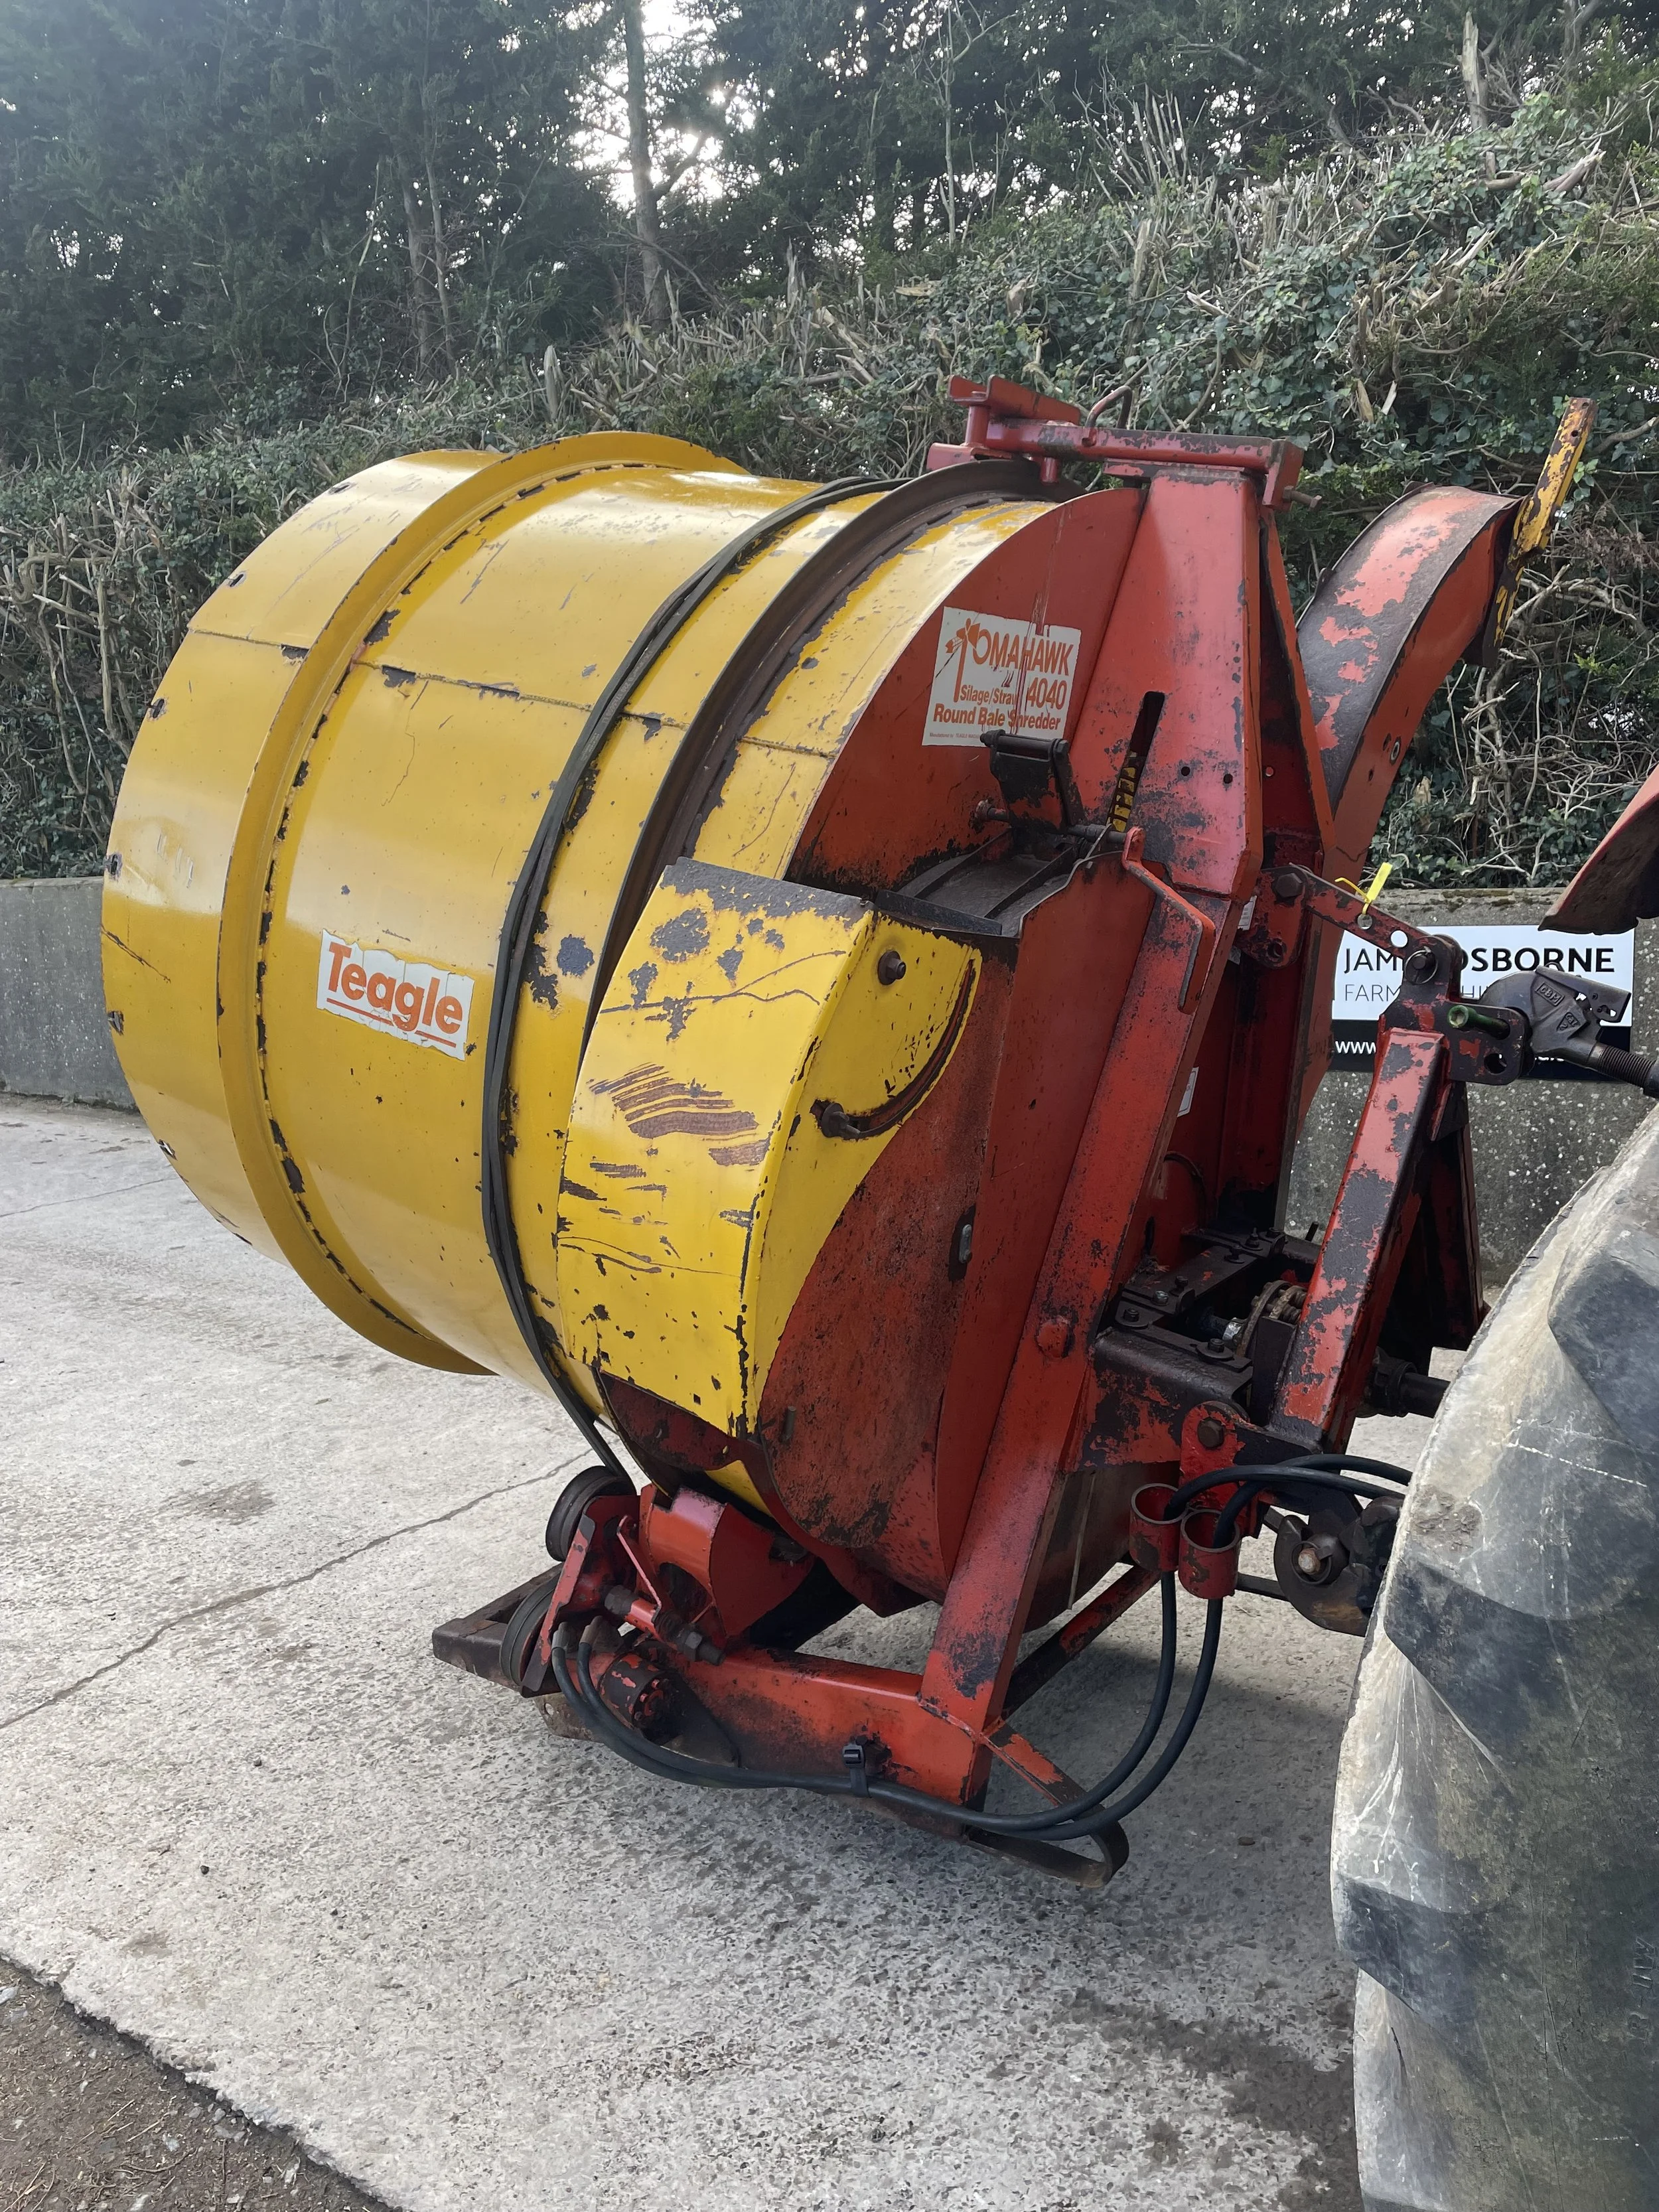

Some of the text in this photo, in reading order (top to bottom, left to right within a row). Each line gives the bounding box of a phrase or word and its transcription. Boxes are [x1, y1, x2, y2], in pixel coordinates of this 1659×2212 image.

[945, 618, 1074, 703] TOMAHAWK
[1027, 677, 1068, 710] 4040
[933, 703, 1061, 730] Round Bale Shredder
[1344, 948, 1404, 974] JAM
[328, 941, 463, 1034] Teagle
